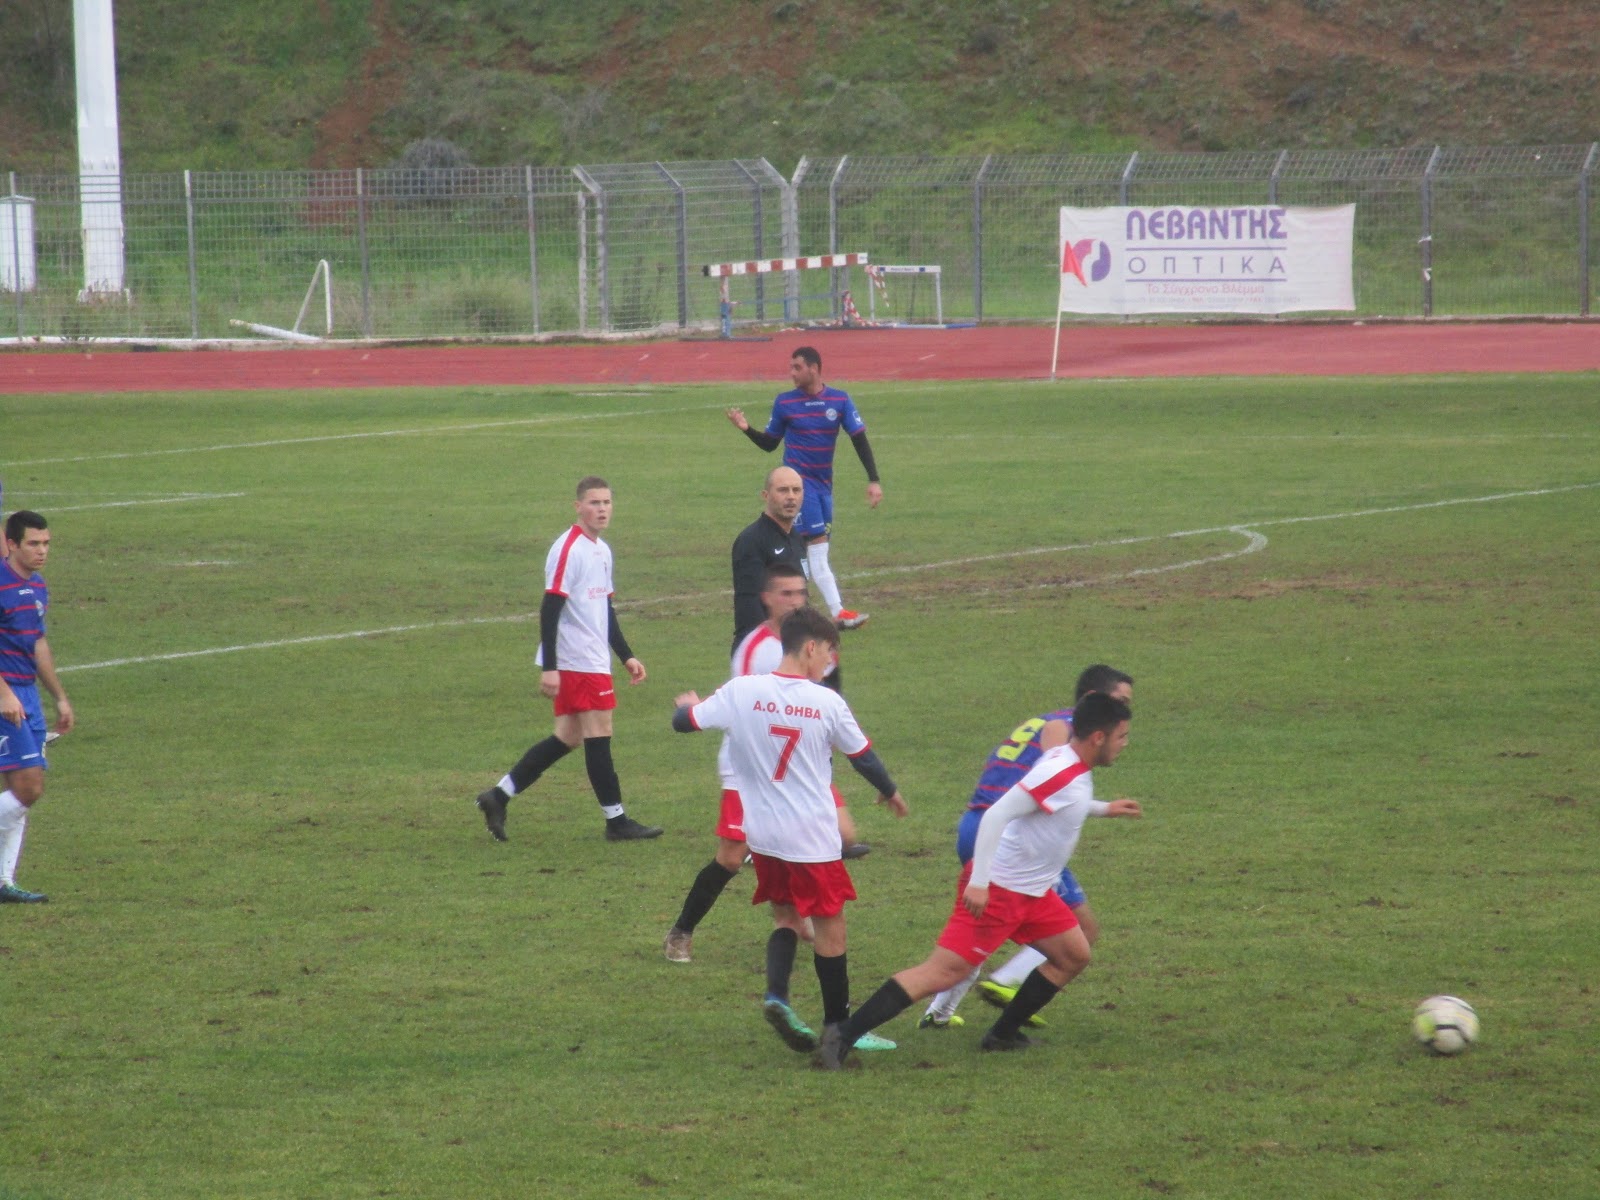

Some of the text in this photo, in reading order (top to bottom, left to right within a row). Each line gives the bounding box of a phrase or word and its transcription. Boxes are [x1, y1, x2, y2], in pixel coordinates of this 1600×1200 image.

[1126, 208, 1288, 240] ΛΕΒΑΝΤΗΣ
[1128, 256, 1285, 274] ΟΠΤΙΚΑ
[1146, 283, 1265, 297] Το Σύγχρονο Βλέμμα
[753, 700, 822, 720] Α.Ο. ΘΗΒΑ
[768, 723, 803, 782] 7
